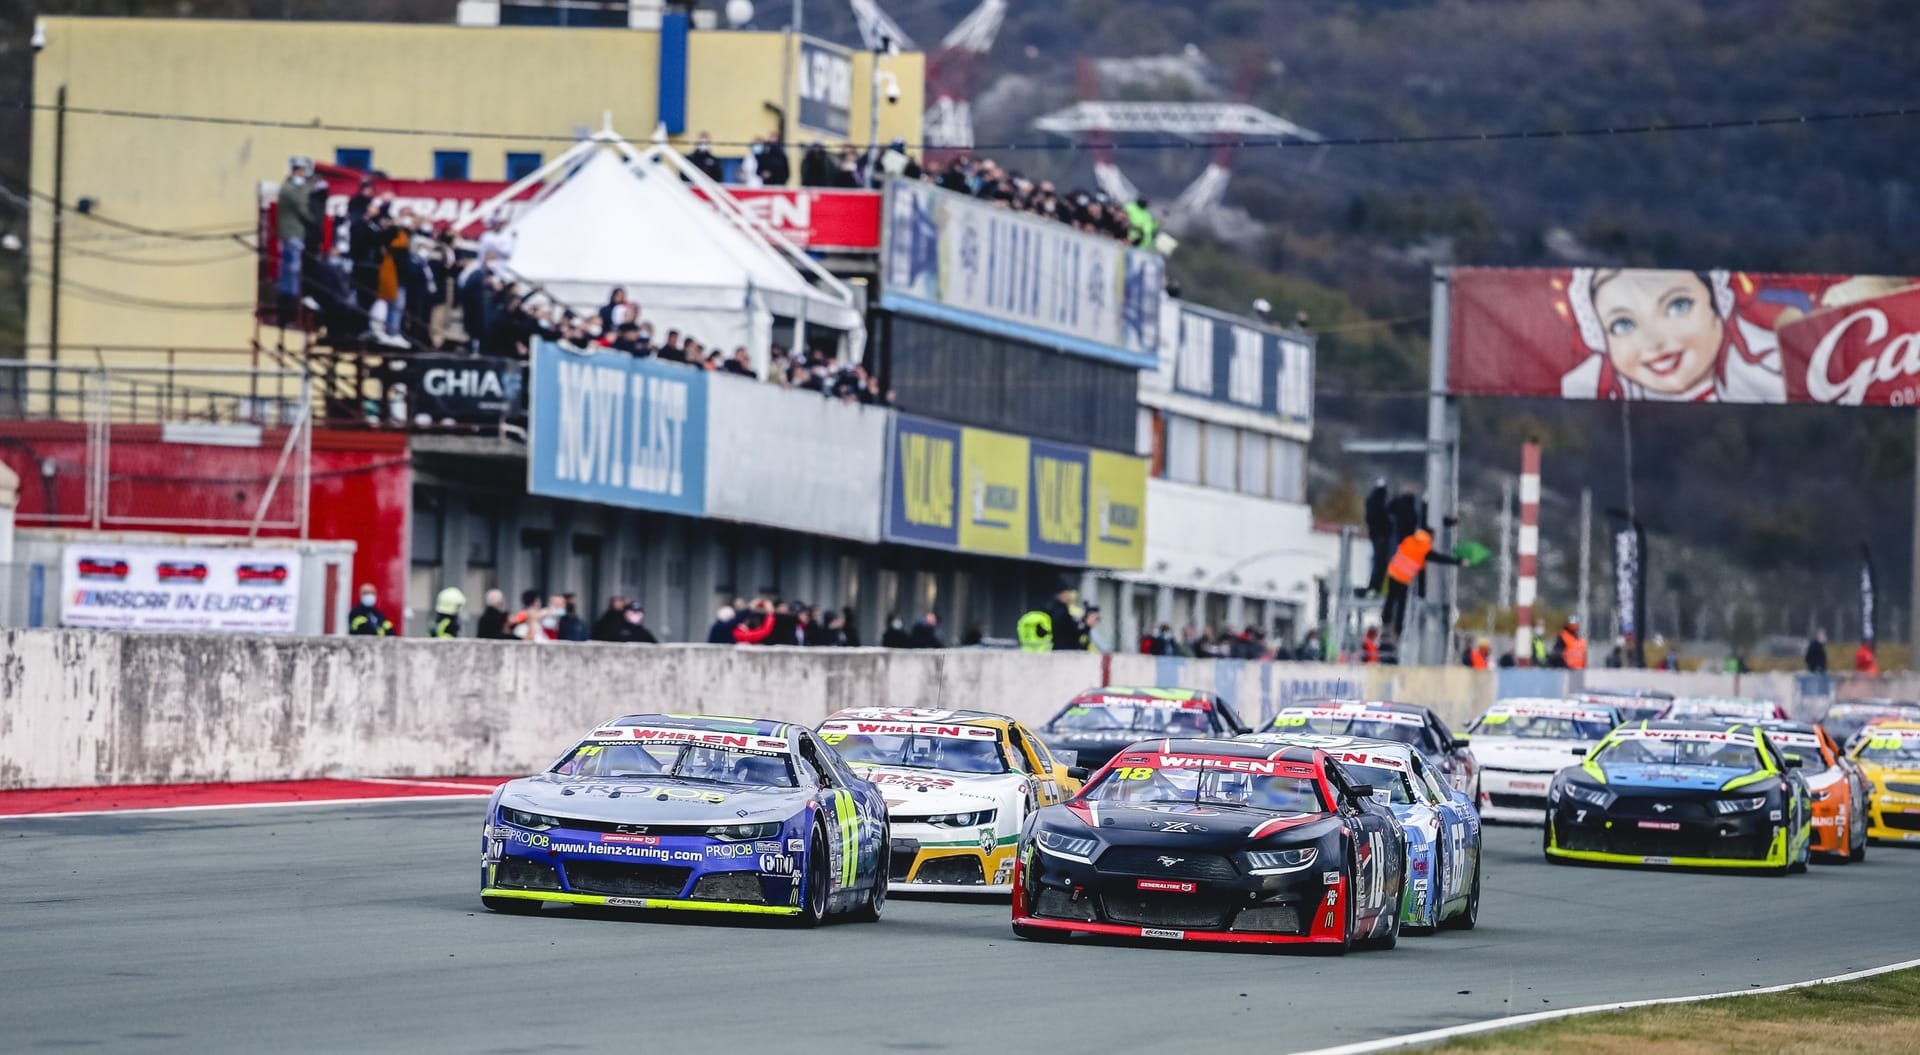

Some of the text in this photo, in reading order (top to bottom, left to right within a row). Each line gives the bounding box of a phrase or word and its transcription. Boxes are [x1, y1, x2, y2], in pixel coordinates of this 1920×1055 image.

[555, 360, 688, 496] NOVI LIST
[92, 590, 290, 613] NASCAR IN EUROPE
[633, 728, 748, 747] WHELEN
[857, 723, 960, 736] WHELEN
[1644, 731, 1727, 741] WHELEN
[575, 745, 602, 757] 11
[598, 739, 778, 757] www.heinz-uning.com
[1158, 755, 1276, 773] WHELEN
[1115, 767, 1155, 781] 18
[1576, 810, 1587, 822] 7
[510, 830, 549, 848] PROJOB
[551, 841, 703, 862] www.heinz-tuning.com
[705, 843, 753, 859] PROJOB
